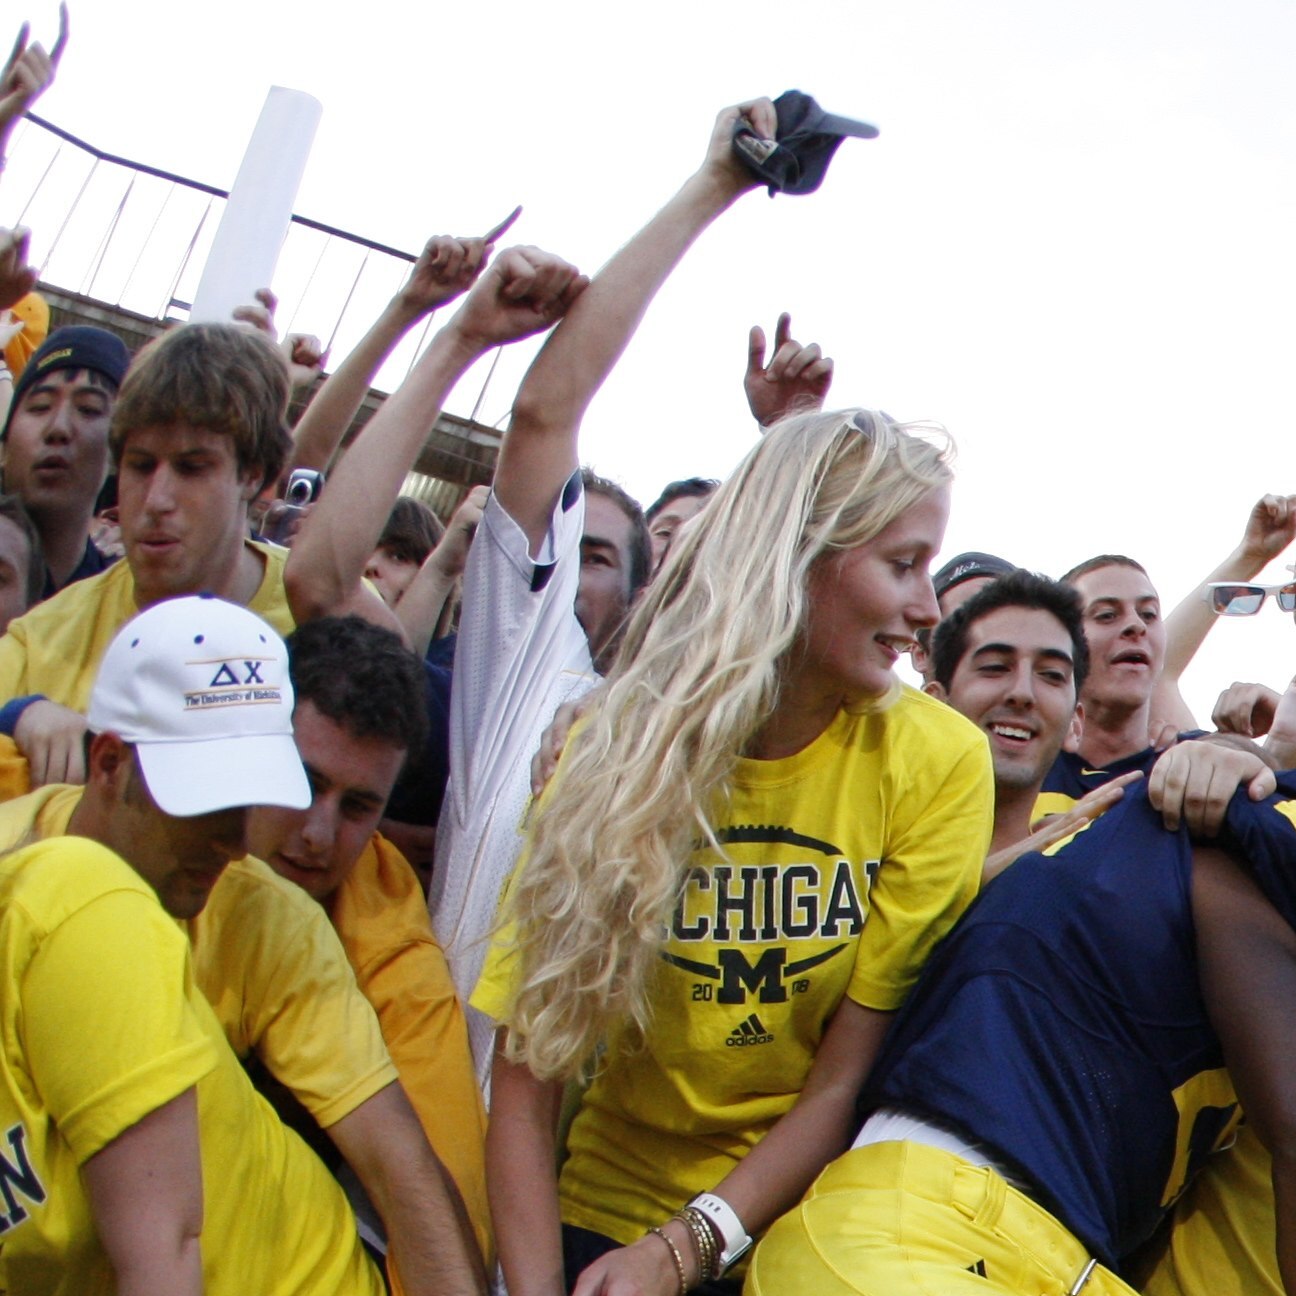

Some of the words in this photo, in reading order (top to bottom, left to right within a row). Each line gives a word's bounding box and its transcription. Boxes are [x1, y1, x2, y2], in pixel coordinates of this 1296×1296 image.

[663, 859, 882, 942] CHIGA
[692, 984, 712, 1001] 20
[717, 948, 789, 1004] M
[725, 1033, 774, 1047] adidas
